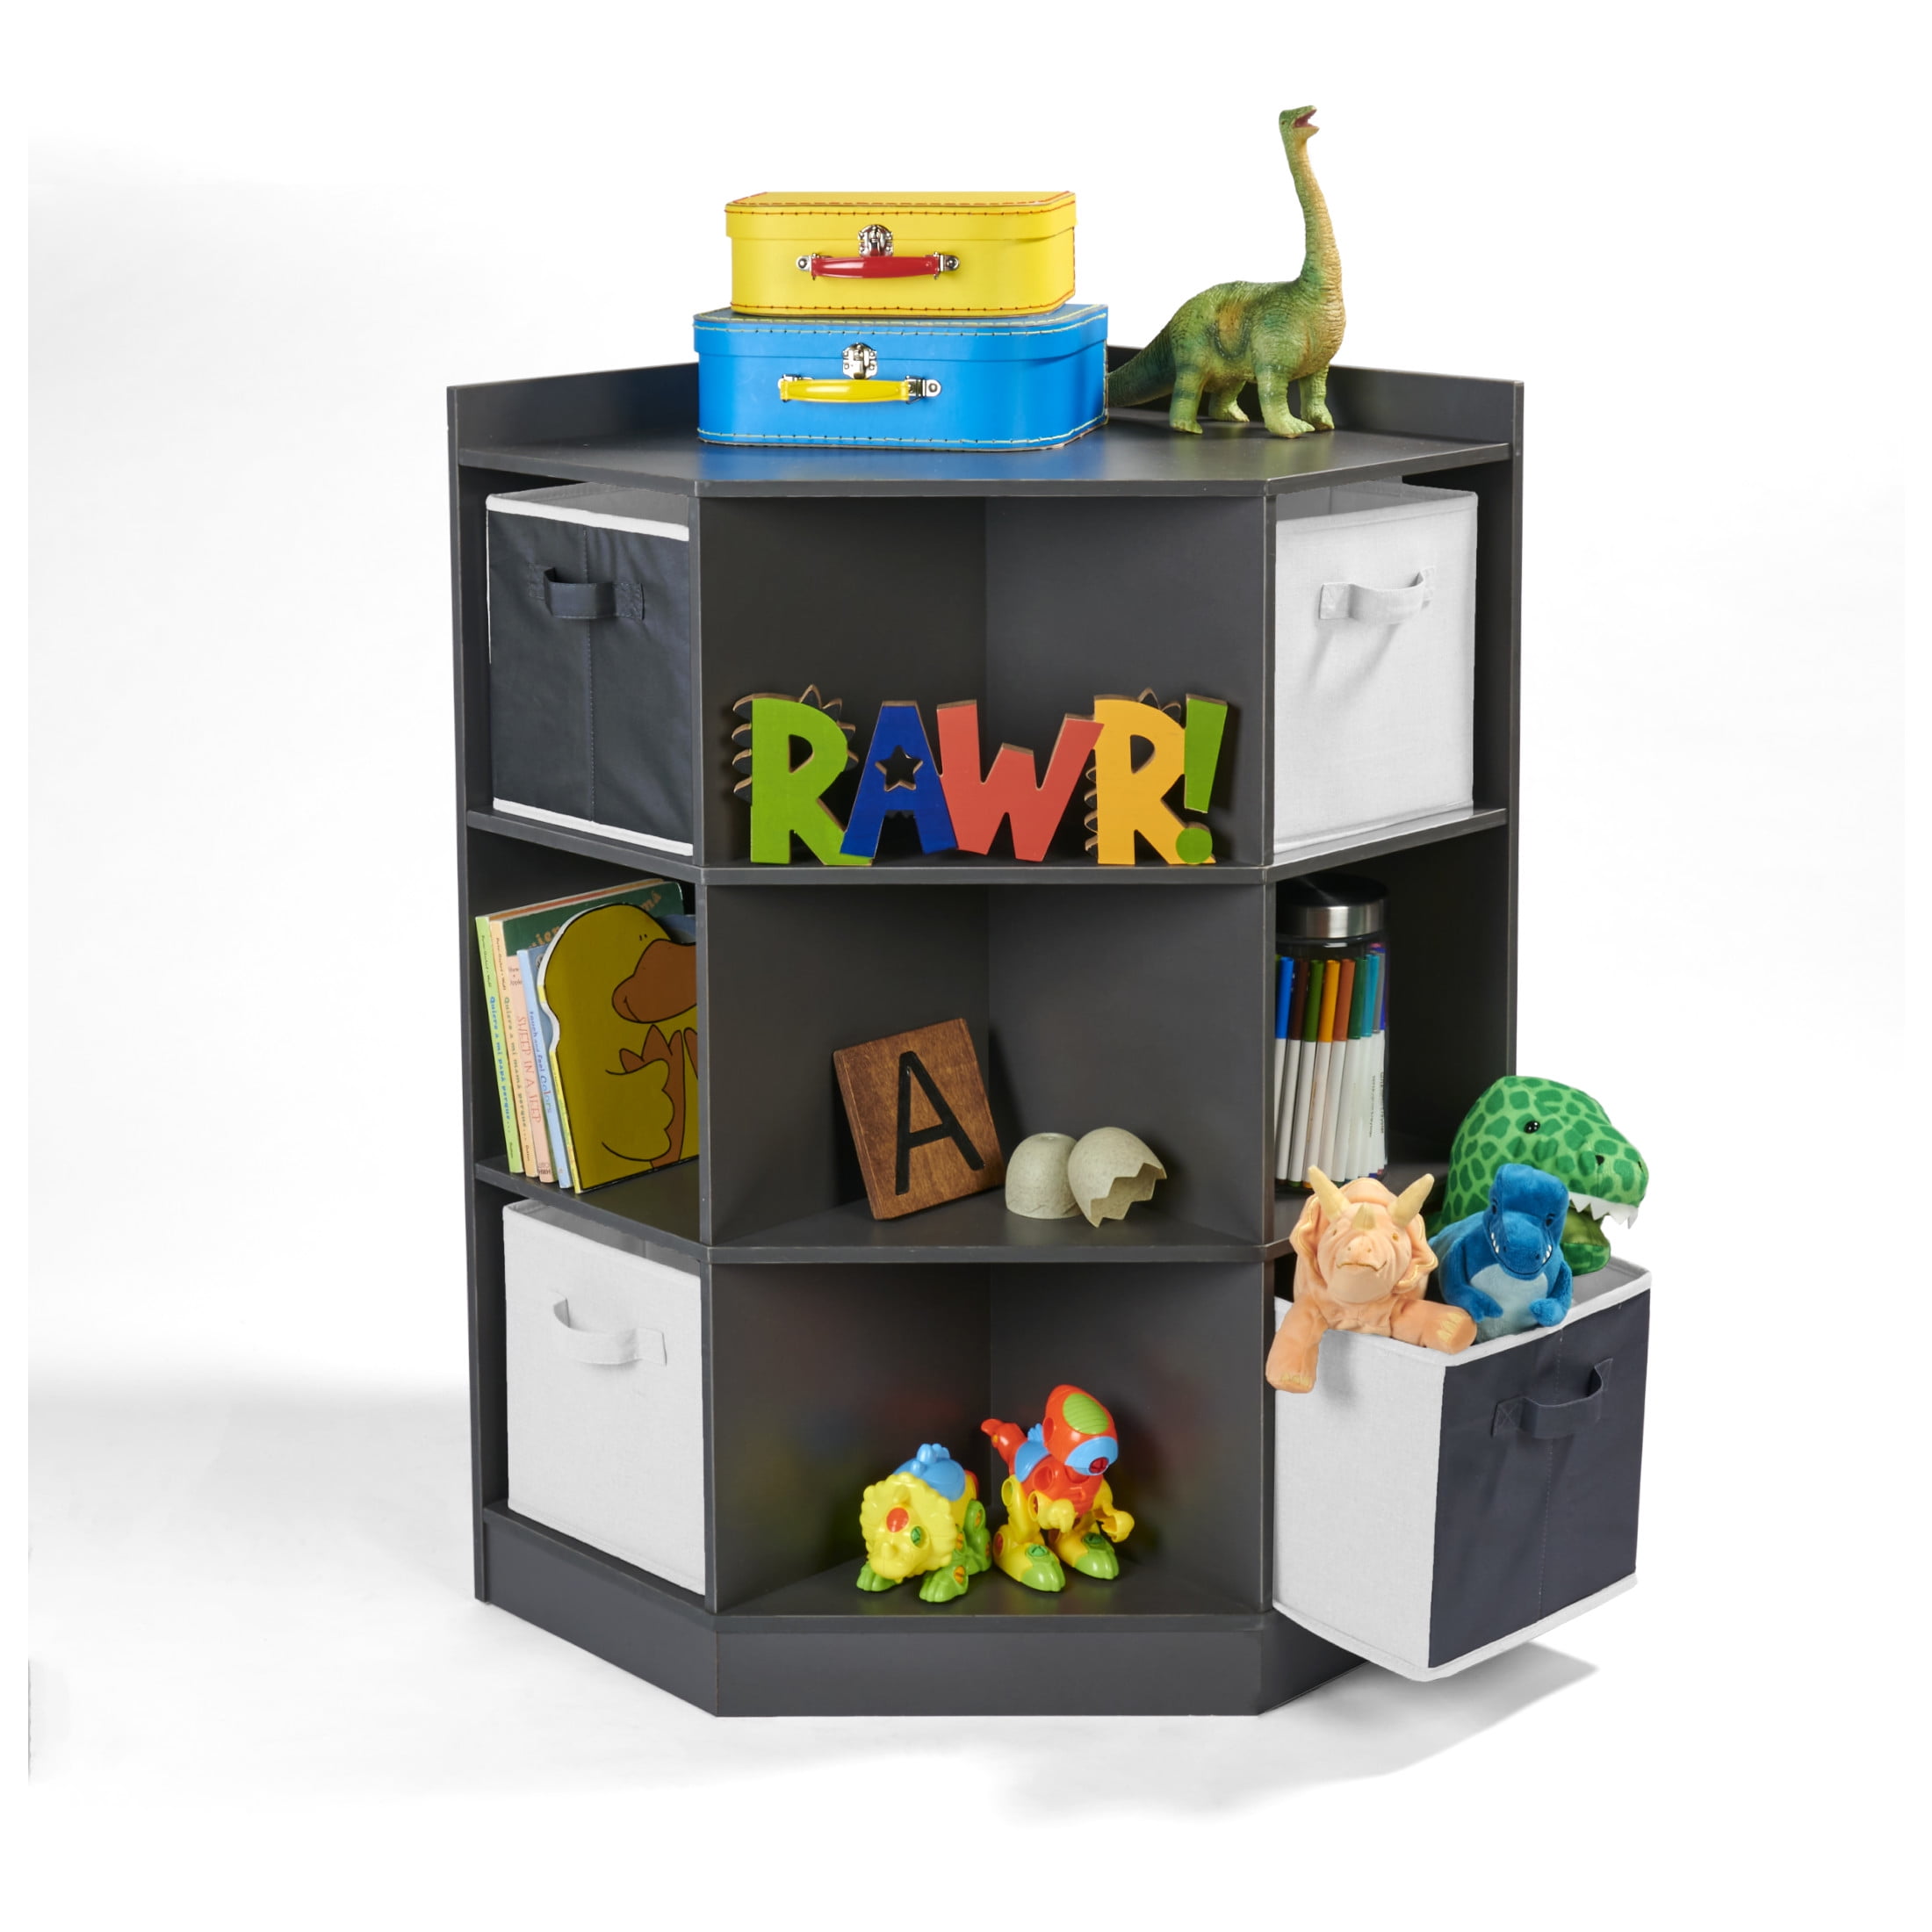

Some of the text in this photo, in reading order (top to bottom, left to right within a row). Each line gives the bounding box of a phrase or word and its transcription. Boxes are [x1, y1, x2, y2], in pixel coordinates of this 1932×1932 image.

[749, 694, 1228, 866] RAWR!
[524, 1078, 536, 1088] A
[895, 1049, 985, 1196] A
